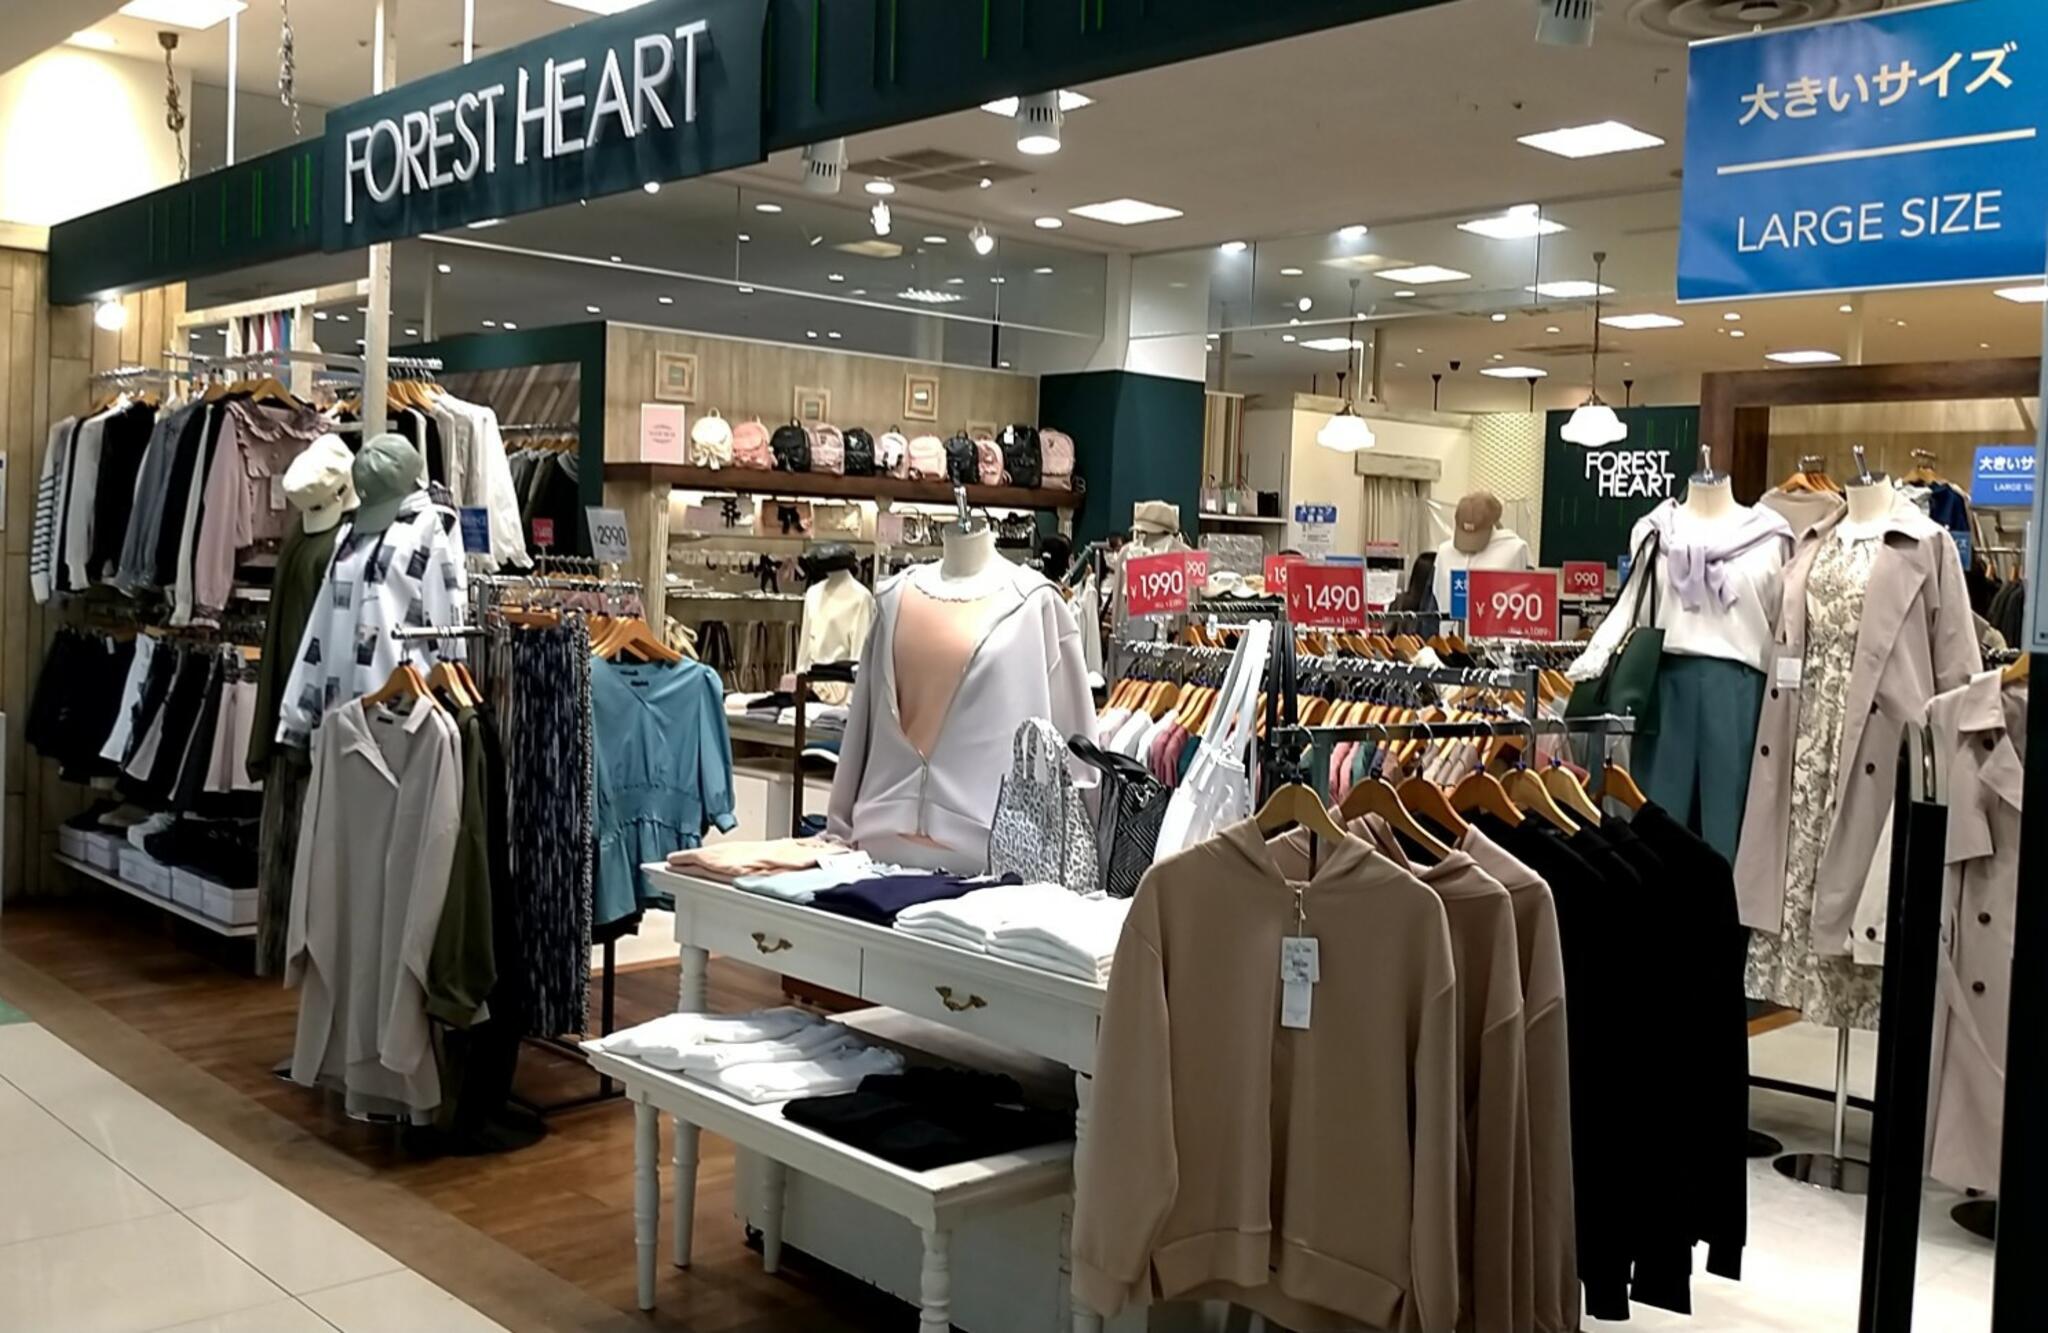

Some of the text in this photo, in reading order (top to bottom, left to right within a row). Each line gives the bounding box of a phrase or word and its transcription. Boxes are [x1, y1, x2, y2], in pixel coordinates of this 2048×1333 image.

[1738, 41, 2018, 126] 大きいサイズ
[345, 19, 709, 224] FOREST HEART
[1738, 190, 2003, 253] LARGE SIZE
[1585, 450, 1670, 479] FOREST
[1599, 473, 1675, 497] HEART
[597, 525, 627, 547] 2990
[1140, 570, 1184, 600] 1,990
[1574, 572, 1598, 586] 990
[1305, 584, 1360, 613] 1,490
[1492, 591, 1542, 622] 990
